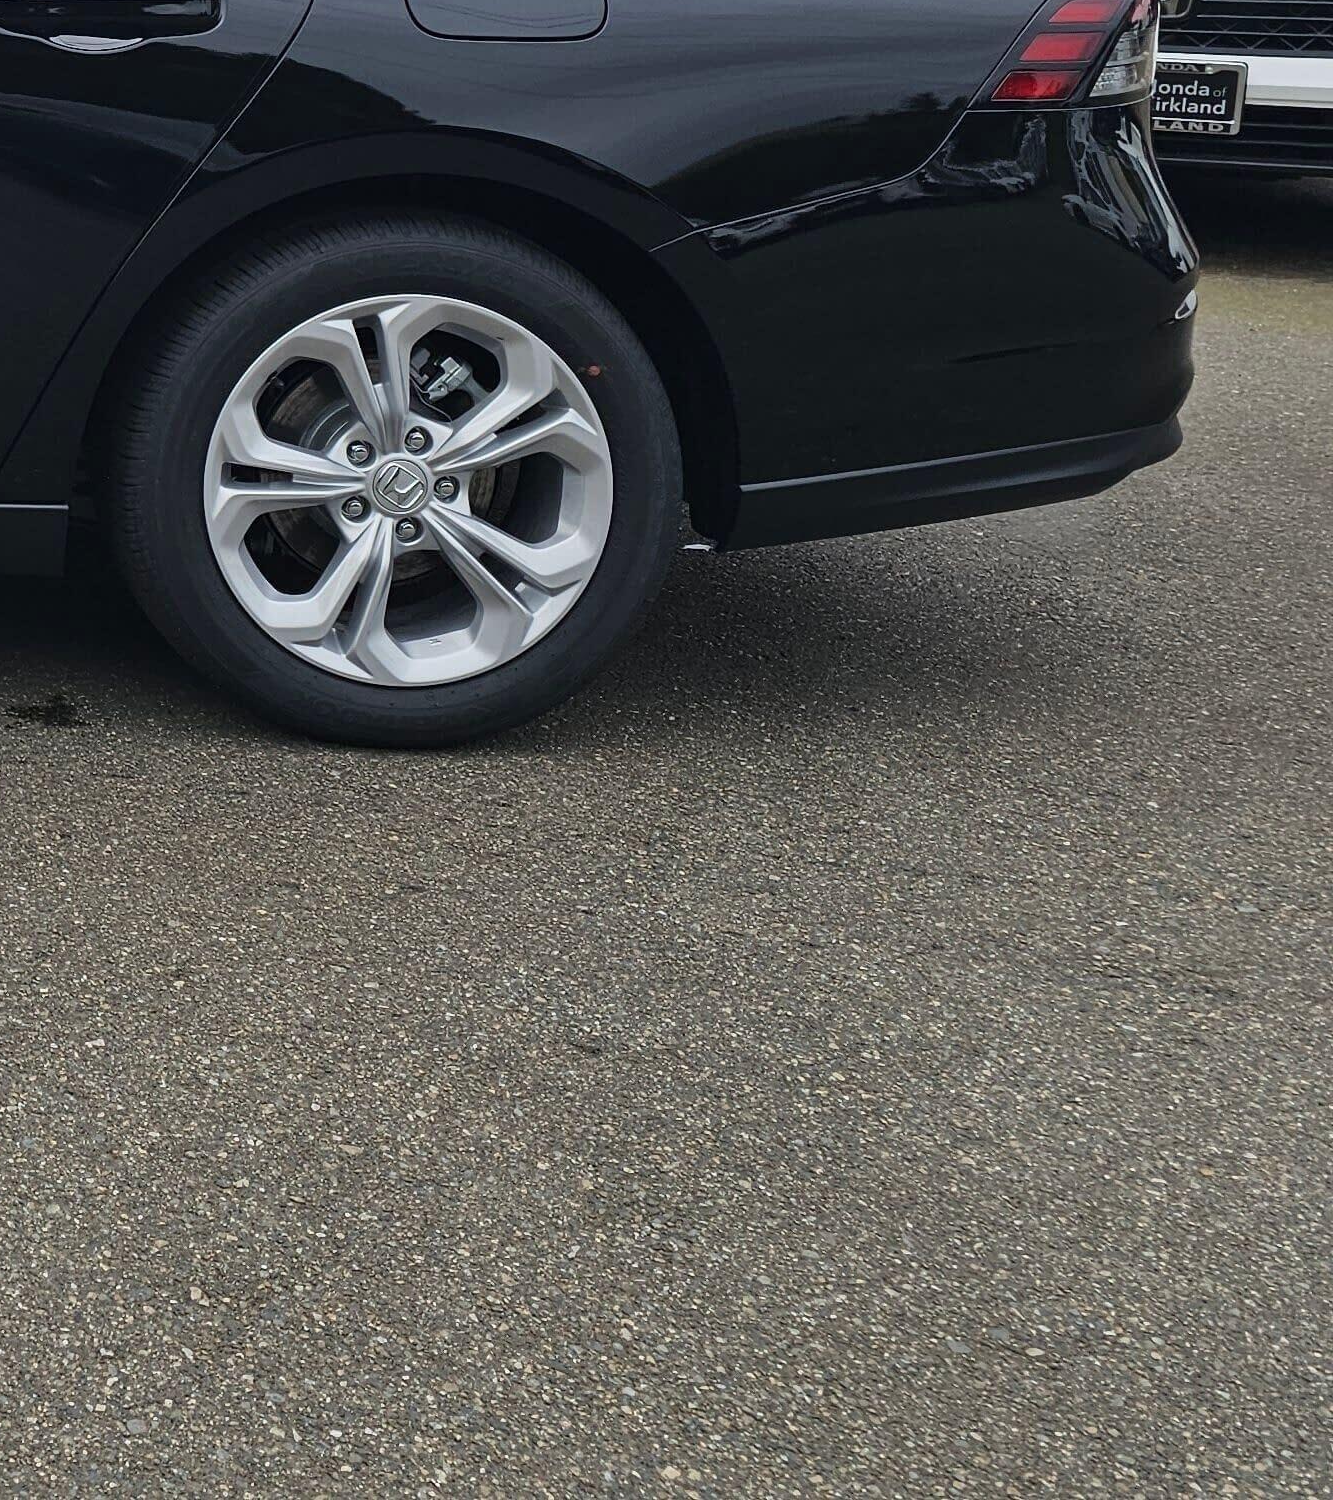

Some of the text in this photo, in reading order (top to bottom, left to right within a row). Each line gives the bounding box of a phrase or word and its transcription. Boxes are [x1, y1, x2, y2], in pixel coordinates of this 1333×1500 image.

[1156, 62, 1200, 73] NDA
[1213, 87, 1227, 98] of
[1152, 96, 1227, 115] irkland
